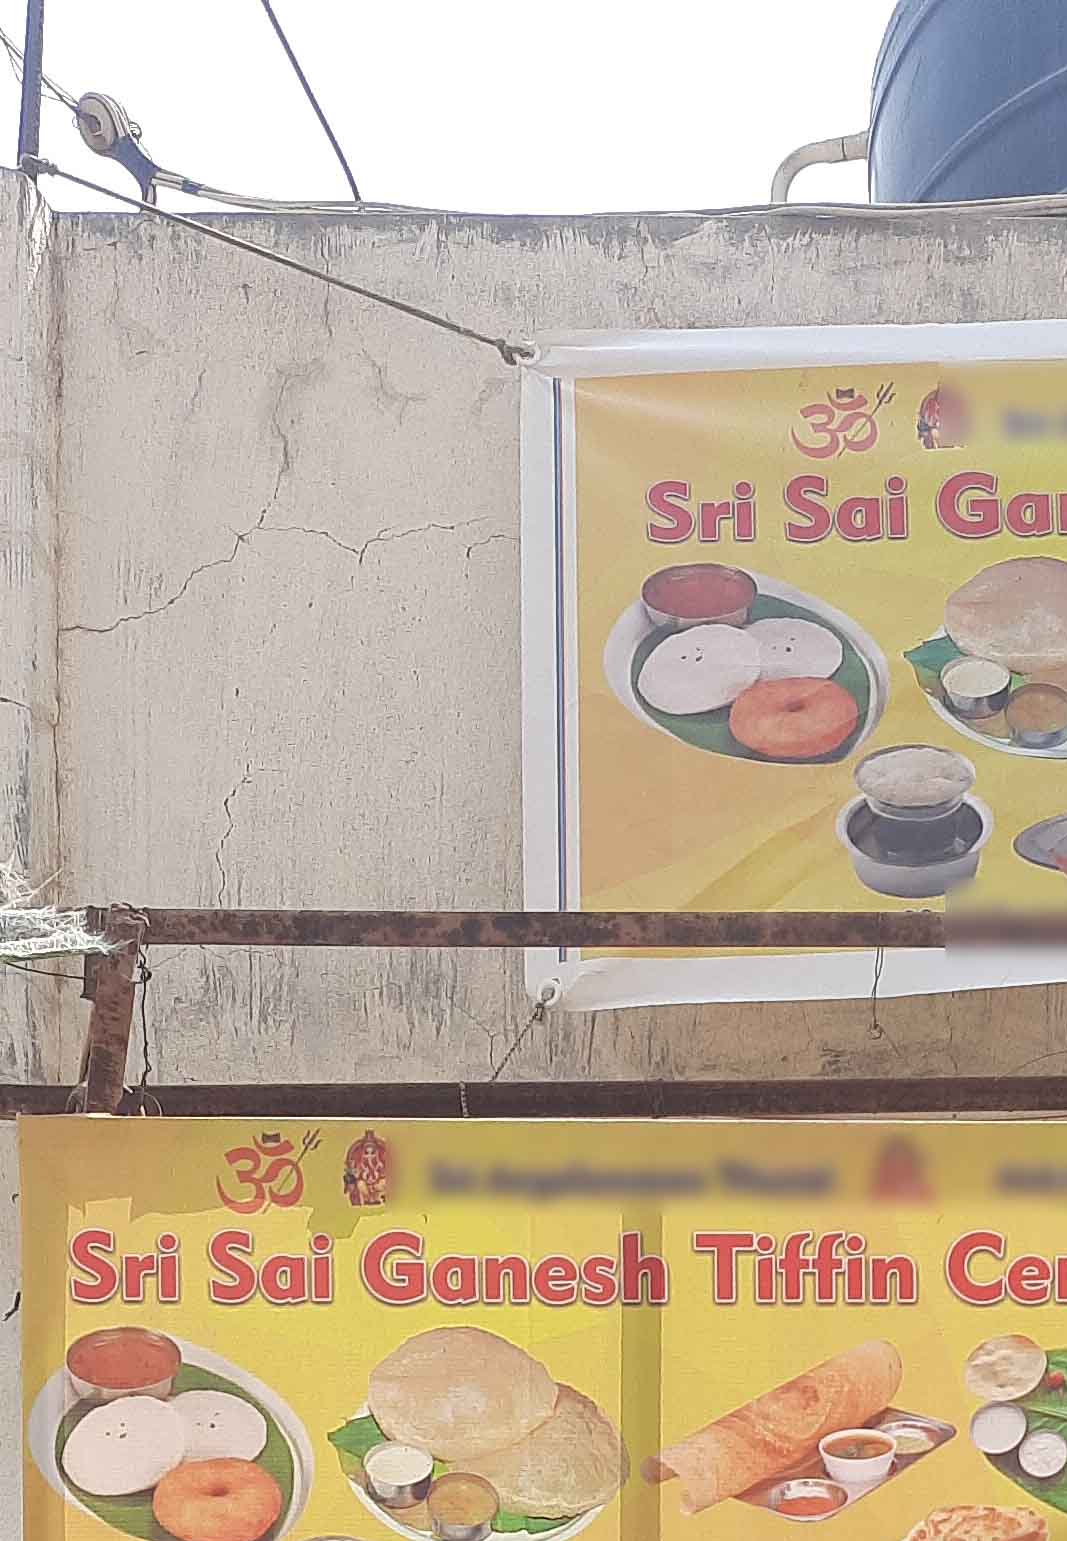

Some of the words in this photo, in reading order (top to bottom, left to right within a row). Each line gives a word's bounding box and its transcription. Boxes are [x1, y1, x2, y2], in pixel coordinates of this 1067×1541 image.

[646, 479, 757, 543] Sri
[784, 475, 909, 542] Sai
[69, 1230, 180, 1305] Sri
[209, 1231, 334, 1306] Sai
[362, 1231, 670, 1307] Ganesh
[692, 1230, 918, 1306] Tiffin
